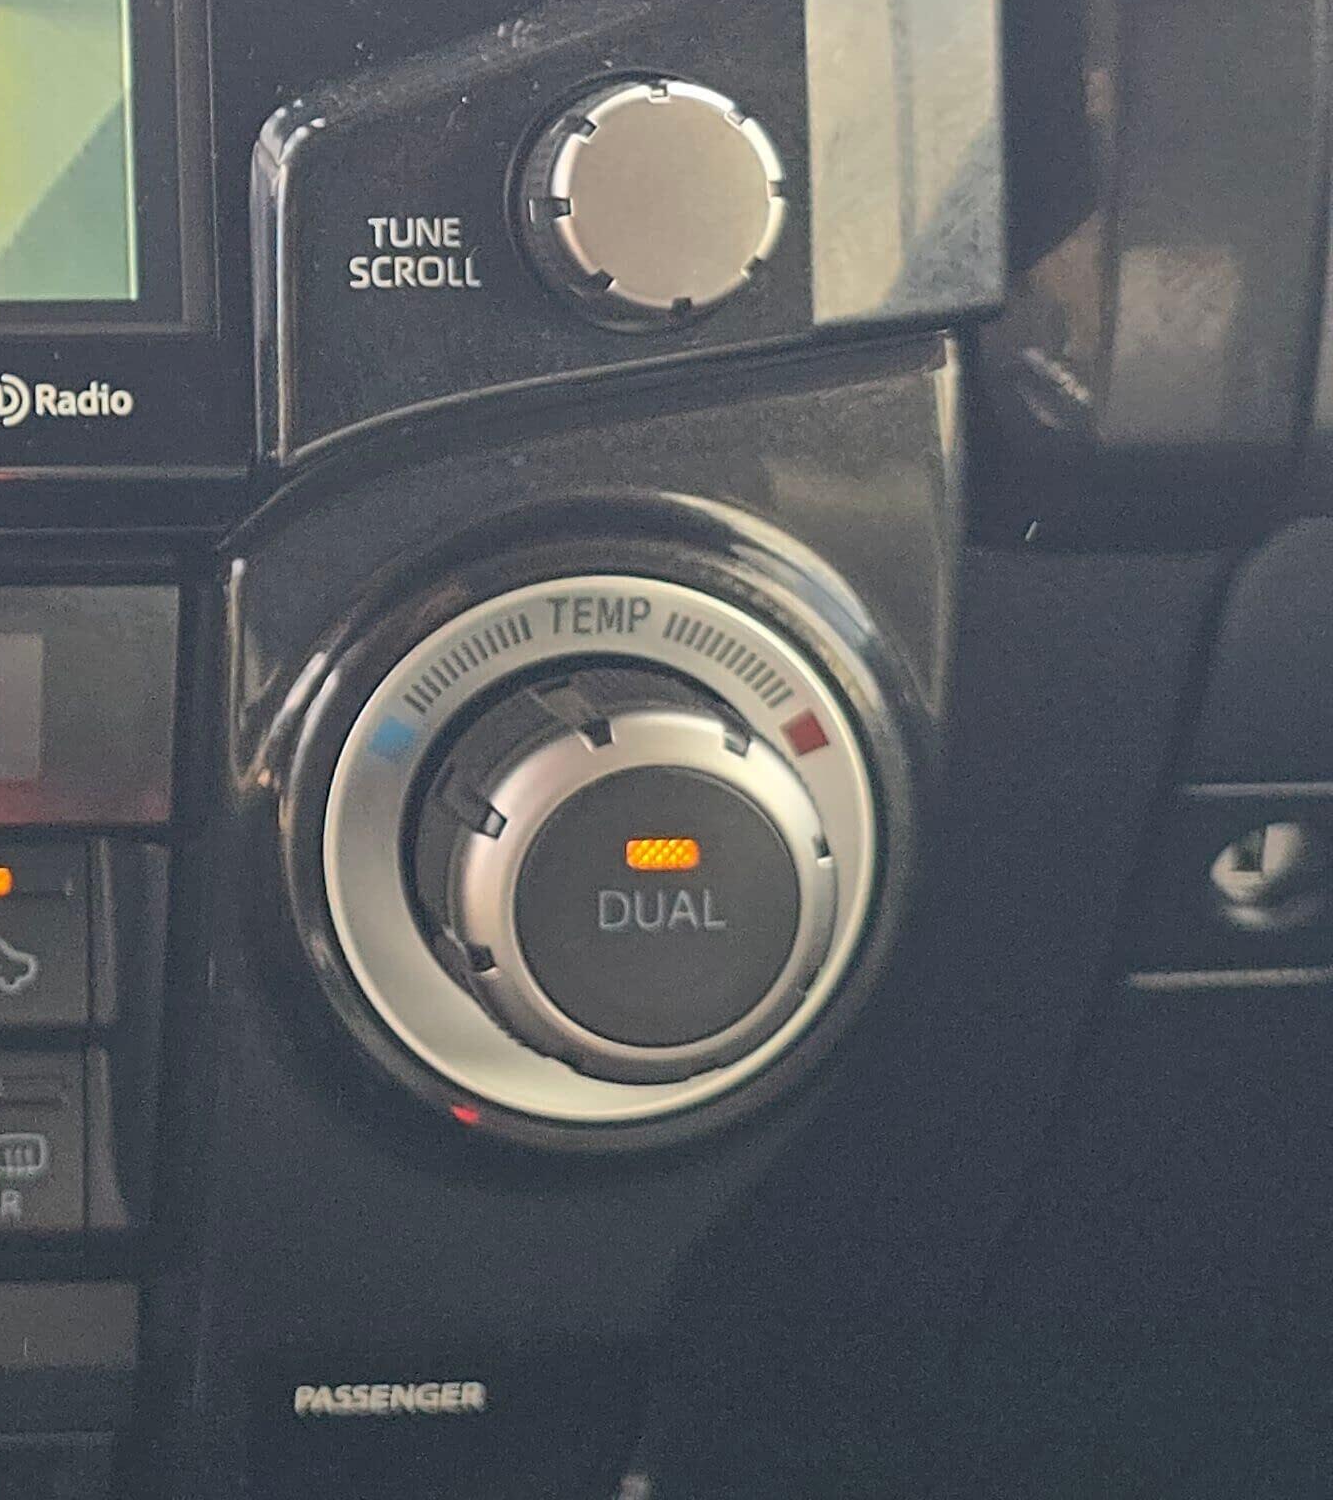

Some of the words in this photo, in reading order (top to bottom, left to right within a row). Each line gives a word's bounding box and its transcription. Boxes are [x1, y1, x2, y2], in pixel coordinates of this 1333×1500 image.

[367, 216, 463, 249] TUNE
[348, 256, 483, 289] SCROLL
[36, 382, 133, 417] Radio
[548, 596, 652, 635] TEMP
[598, 888, 726, 932] DUAL
[294, 1381, 486, 1416] PASSENGER
